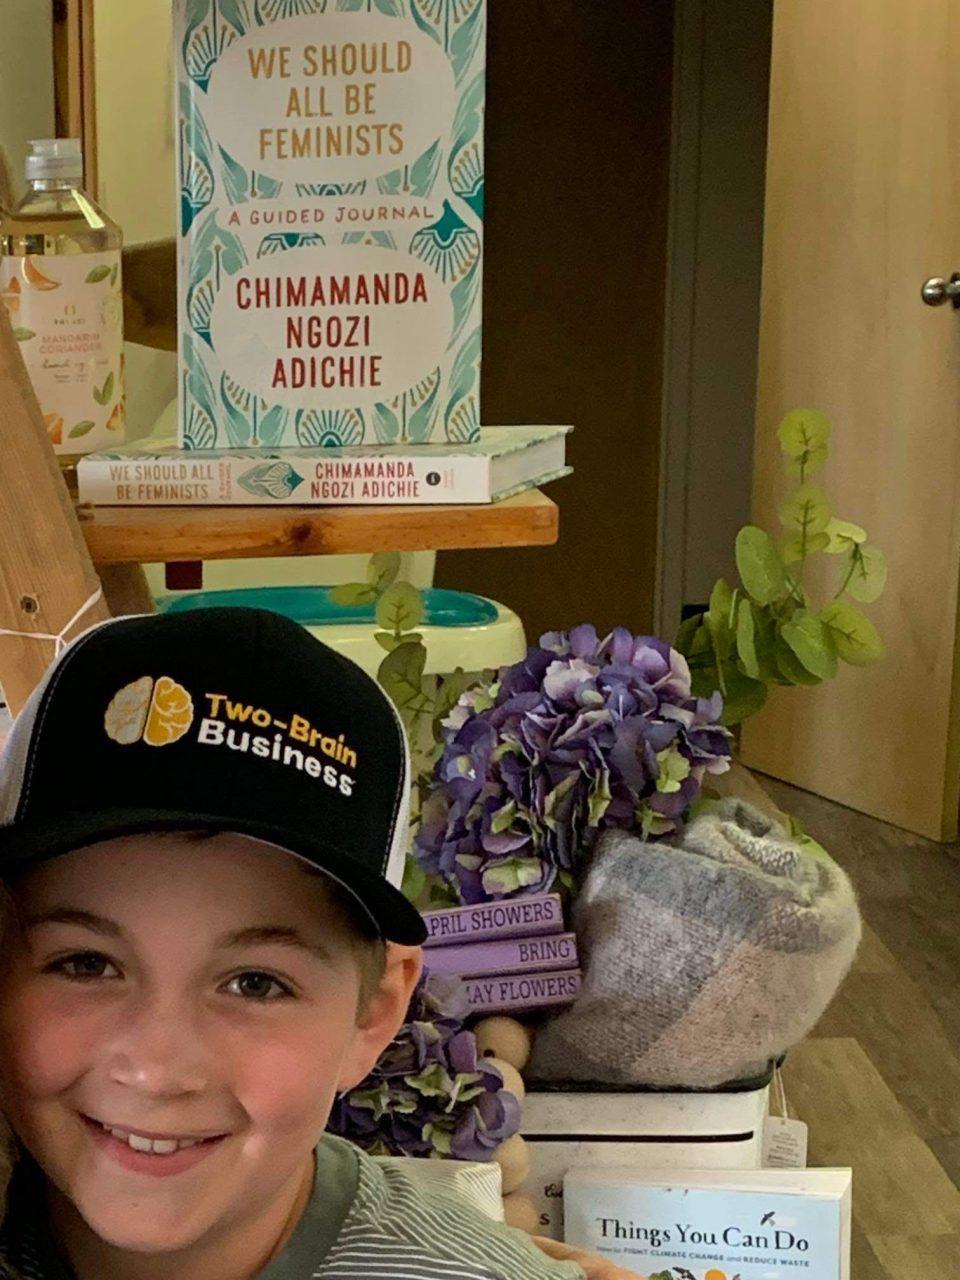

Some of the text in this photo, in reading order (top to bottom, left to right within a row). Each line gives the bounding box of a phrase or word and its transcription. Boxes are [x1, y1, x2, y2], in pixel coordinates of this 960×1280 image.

[248, 41, 412, 79] WE SHOULD
[286, 83, 376, 117] ALL BE
[259, 123, 404, 160] FEMINISTS
[228, 206, 434, 226] A GUIDED JOURNAL
[236, 272, 428, 310] CHIMAMANDA
[286, 315, 370, 349] NGOZI
[272, 355, 383, 389] ADICHIE
[109, 463, 215, 481] WE SHOULD ALL
[315, 461, 415, 479] CHIMAMANDA
[116, 484, 209, 500] BE FEMINISTS
[310, 481, 355, 499] NGOZI
[361, 480, 421, 499] ADICHIE
[205, 693, 357, 768] Two-Brain
[197, 718, 356, 796] Business
[426, 901, 554, 937] PRIL SHOWERS
[518, 940, 570, 963] BRING
[466, 976, 577, 1004] AY FLOWERS
[596, 1217, 809, 1251] Things You Can Do
[689, 1252, 724, 1262] CHANGE
[743, 1256, 777, 1265] REDUCE
[780, 1258, 809, 1268] WASTE
